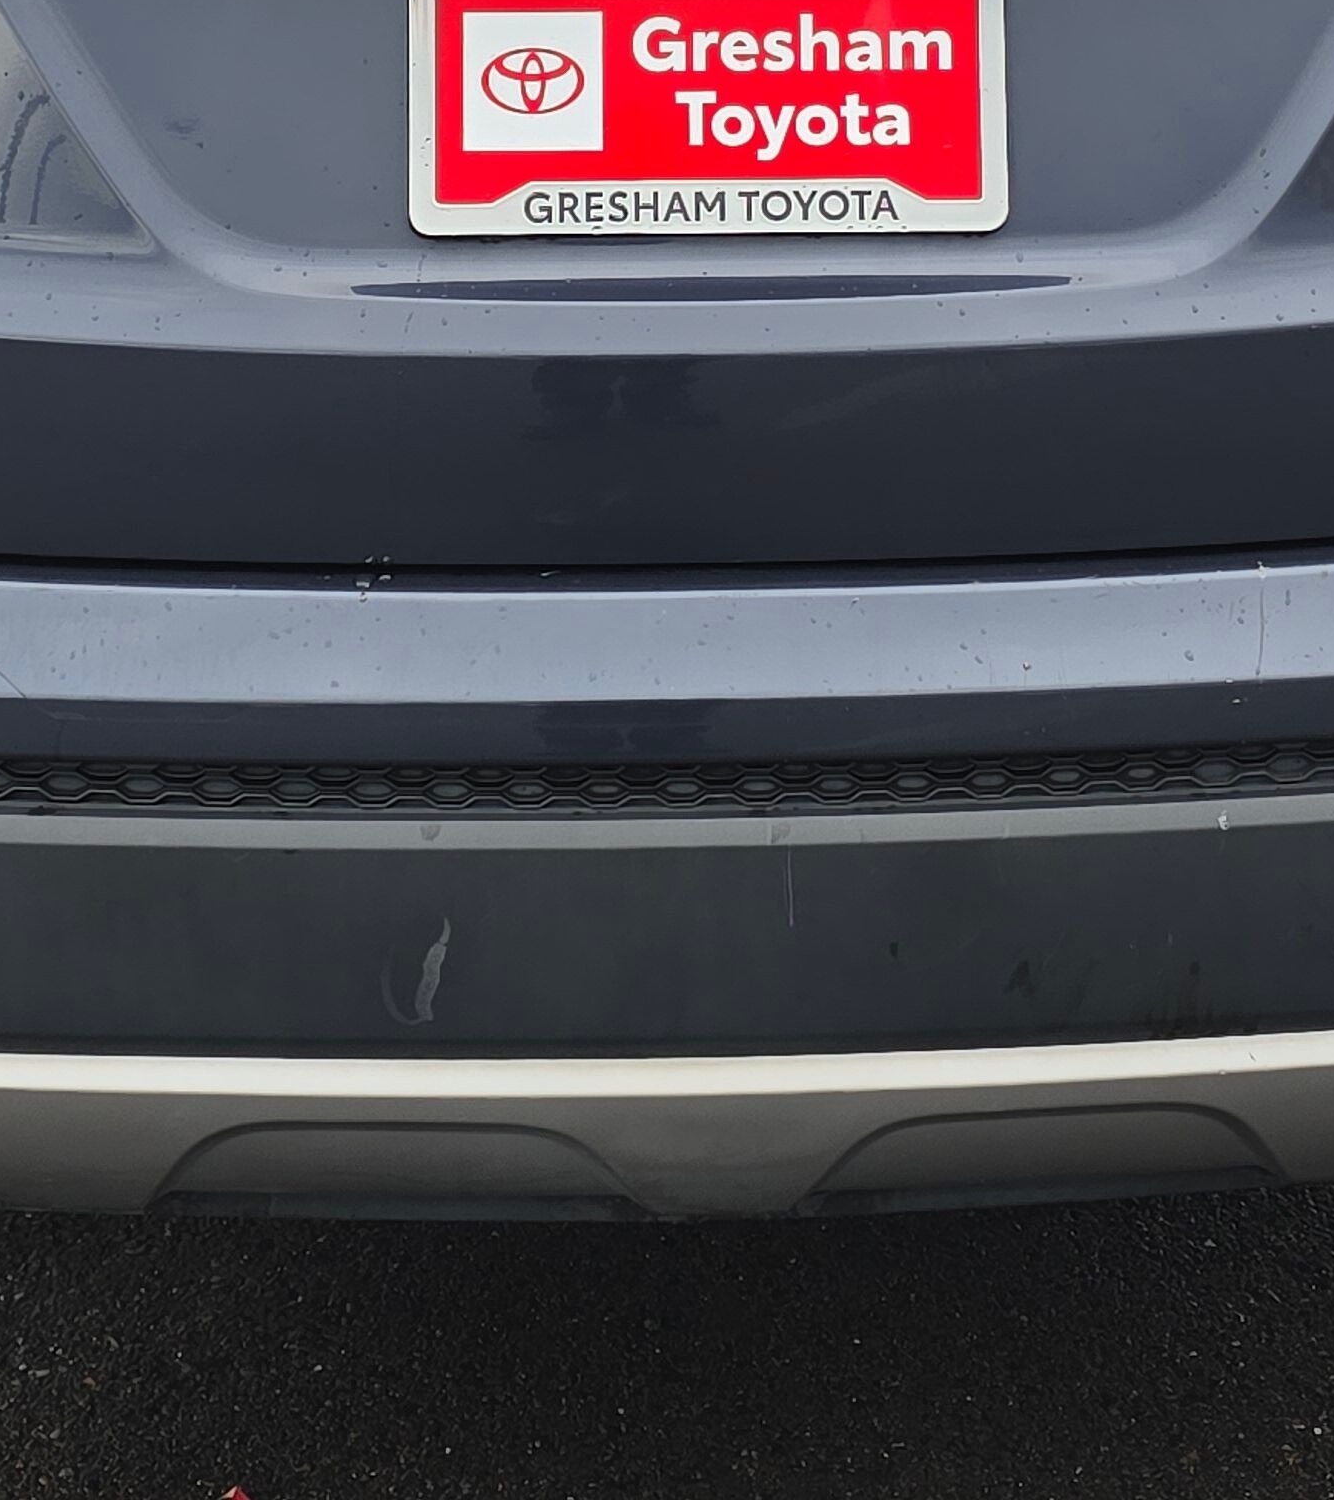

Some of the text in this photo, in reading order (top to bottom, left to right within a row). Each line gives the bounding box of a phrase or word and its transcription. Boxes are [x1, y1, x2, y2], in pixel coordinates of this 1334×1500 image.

[632, 13, 953, 73] Gresham
[675, 91, 911, 160] Toyota
[524, 190, 898, 223] GRESHAM TOYOTA
